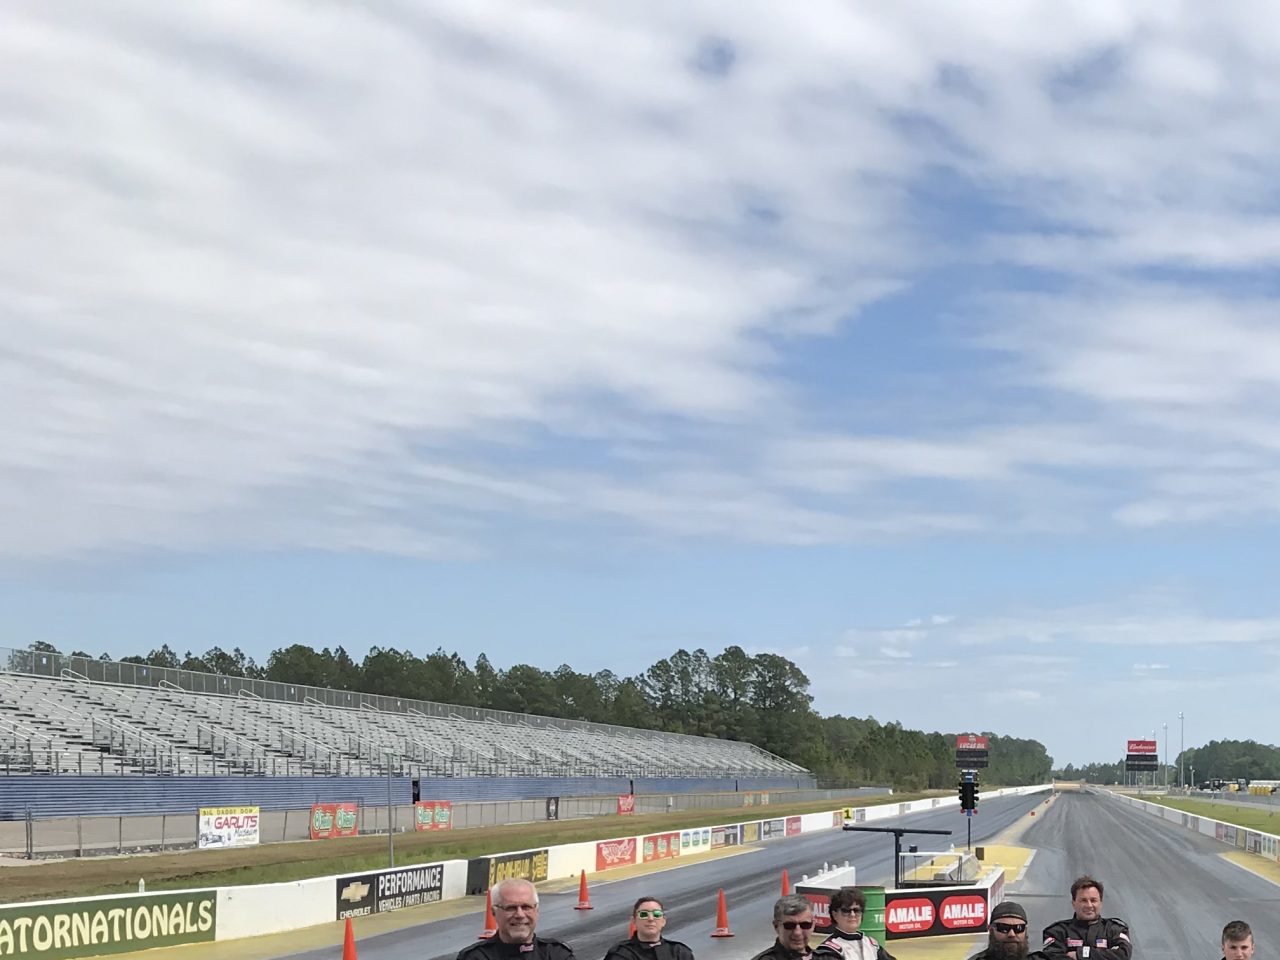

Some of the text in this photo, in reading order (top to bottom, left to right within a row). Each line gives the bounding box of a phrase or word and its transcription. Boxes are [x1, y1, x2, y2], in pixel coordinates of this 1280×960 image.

[844, 808, 852, 819] 1
[214, 815, 258, 830] GARLITS
[378, 867, 441, 898] PERFORMANCE
[378, 898, 402, 913] VEHICLES
[406, 894, 421, 908] PARTS
[424, 890, 440, 905] RACING
[340, 906, 372, 919] CHEVROLET
[888, 906, 932, 924] AMALIE
[943, 903, 985, 919] AMALIE
